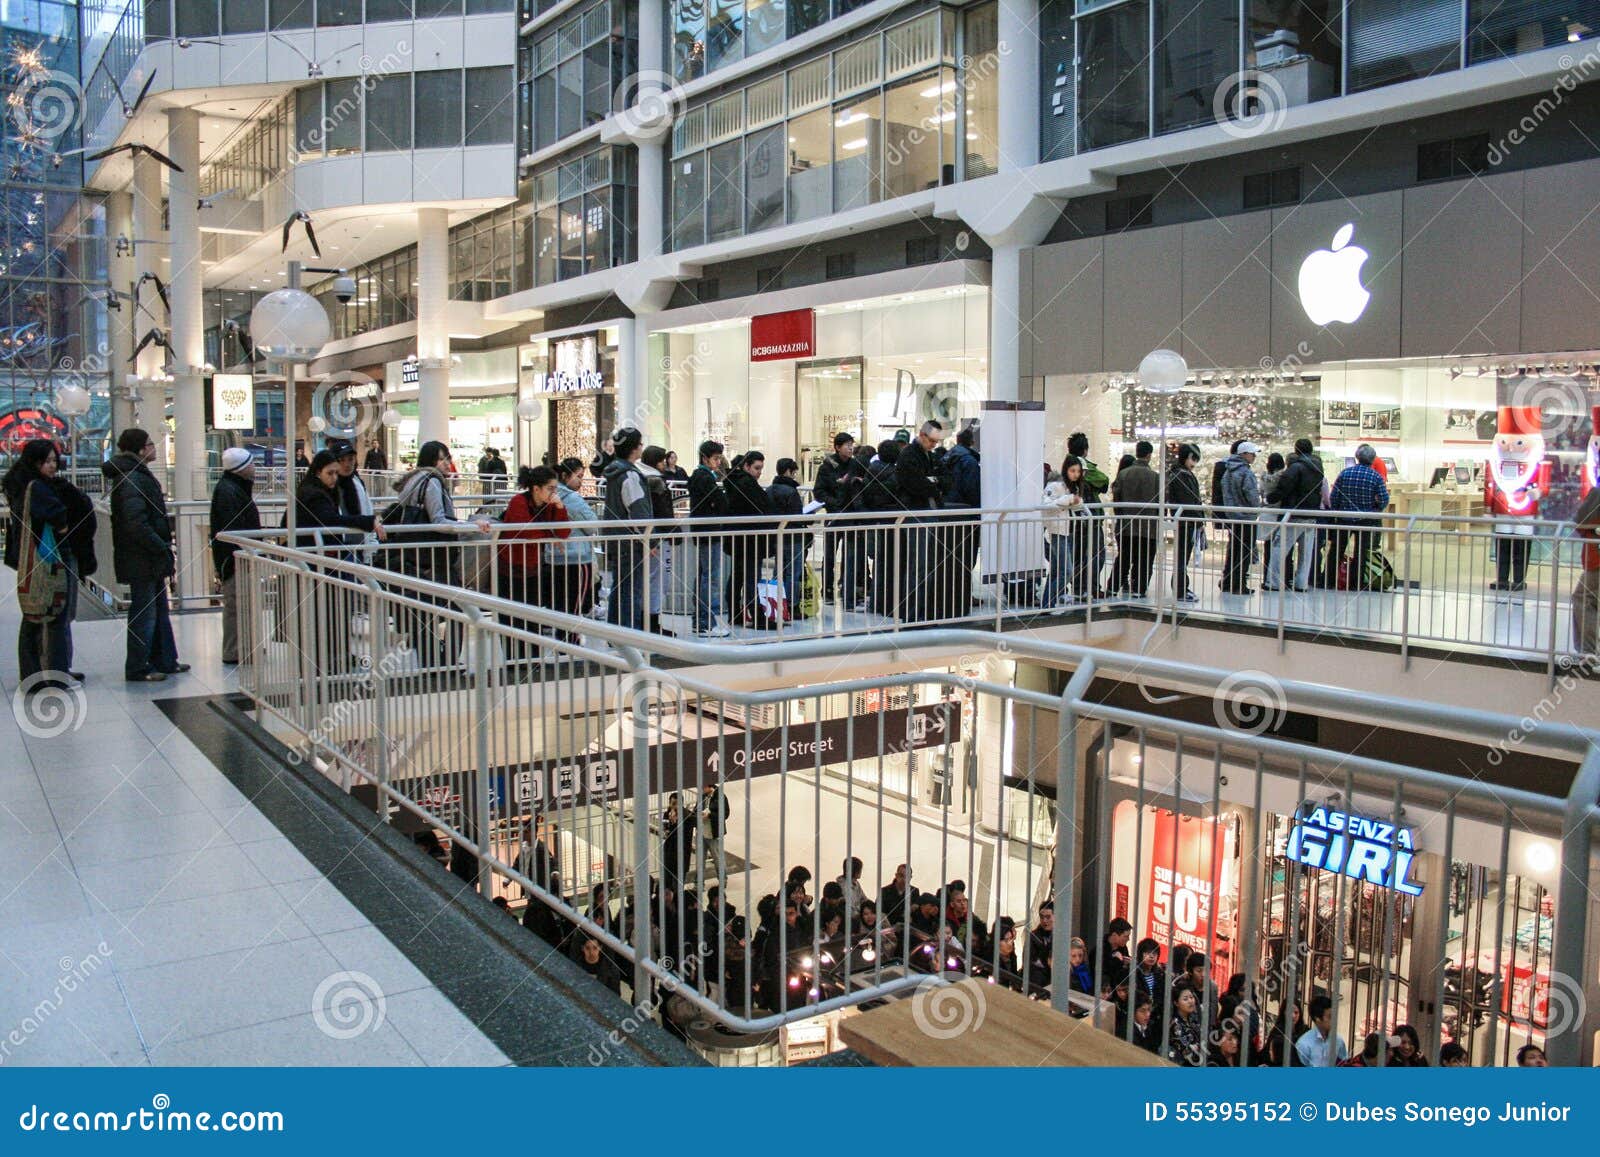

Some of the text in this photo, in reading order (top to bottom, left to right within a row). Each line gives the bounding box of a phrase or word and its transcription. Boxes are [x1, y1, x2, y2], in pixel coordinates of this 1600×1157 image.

[752, 342, 809, 357] BCBGMAXAZRIA
[581, 369, 604, 389] Rose
[733, 736, 834, 767] Queen Street
[1286, 825, 1425, 897] GIRL
